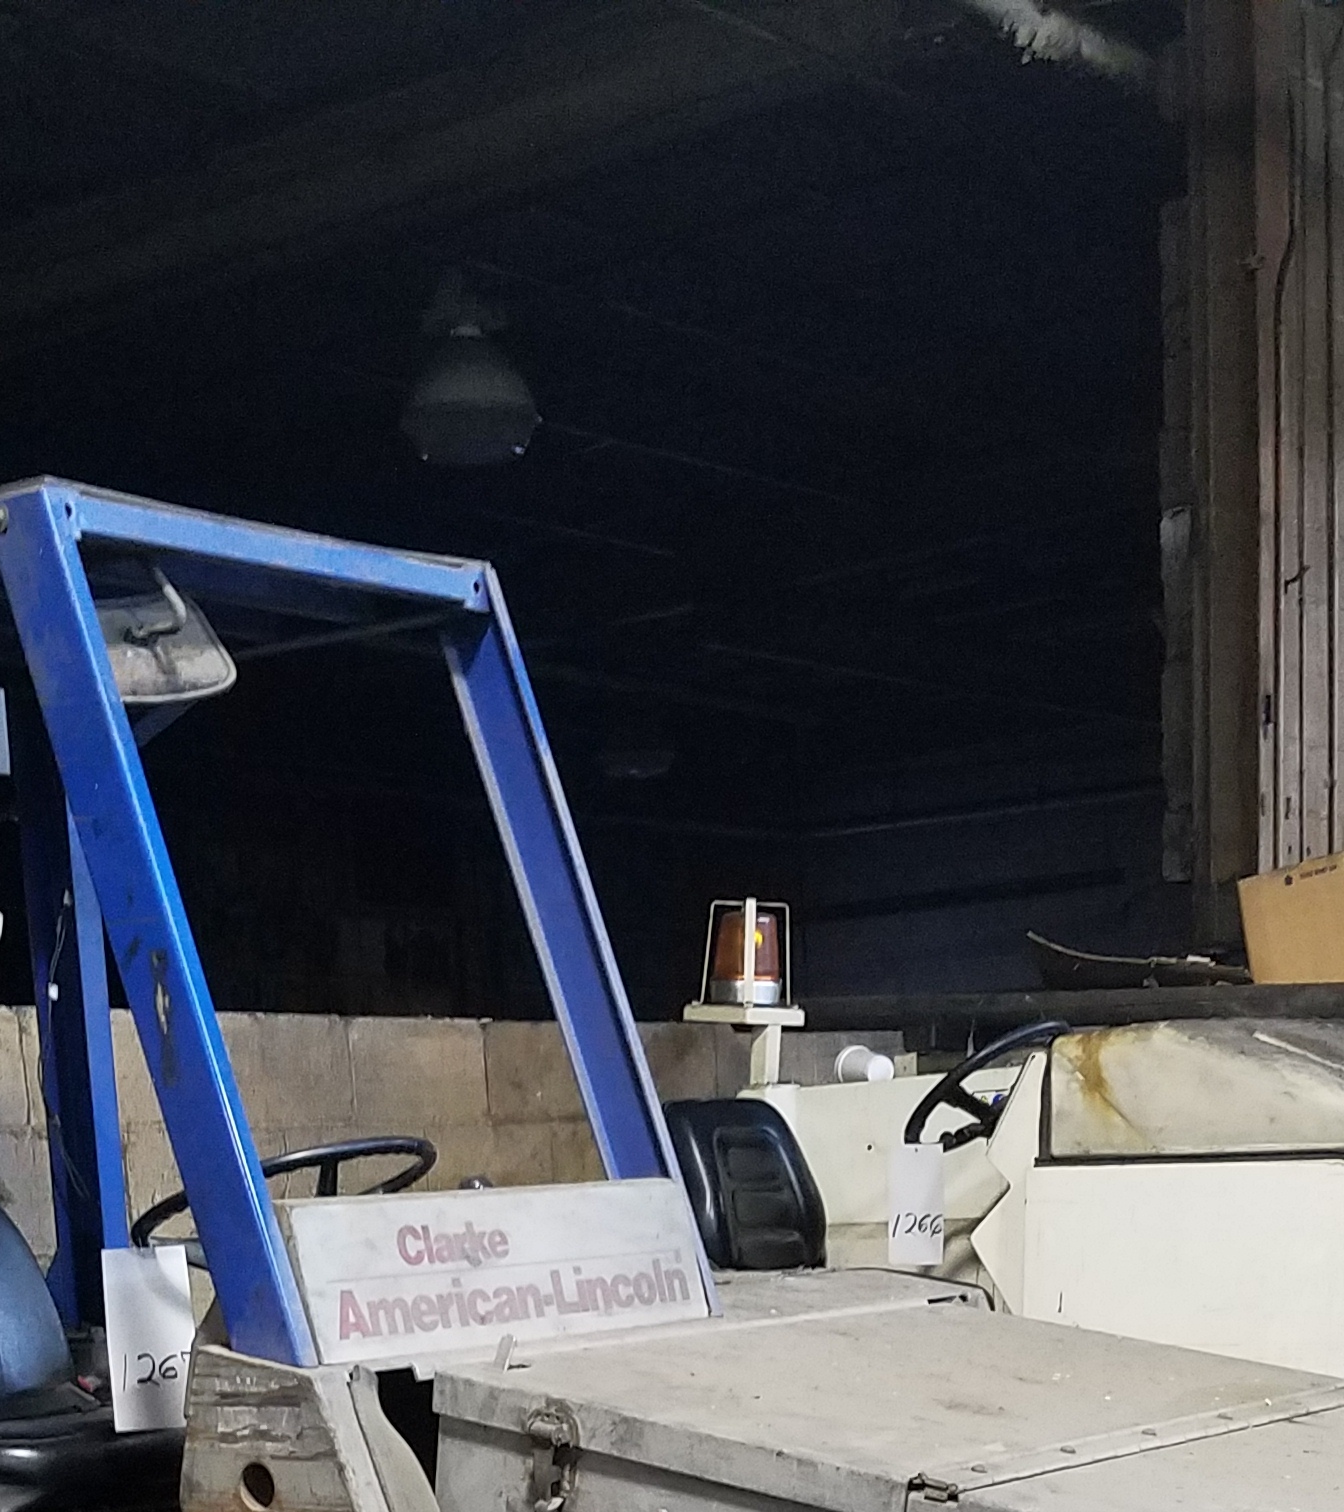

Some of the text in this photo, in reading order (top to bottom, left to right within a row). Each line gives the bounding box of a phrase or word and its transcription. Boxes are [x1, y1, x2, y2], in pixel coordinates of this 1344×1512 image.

[397, 1221, 510, 1266] Clarke
[892, 1212, 944, 1238] 1266
[339, 1258, 691, 1341] American-Lincoln
